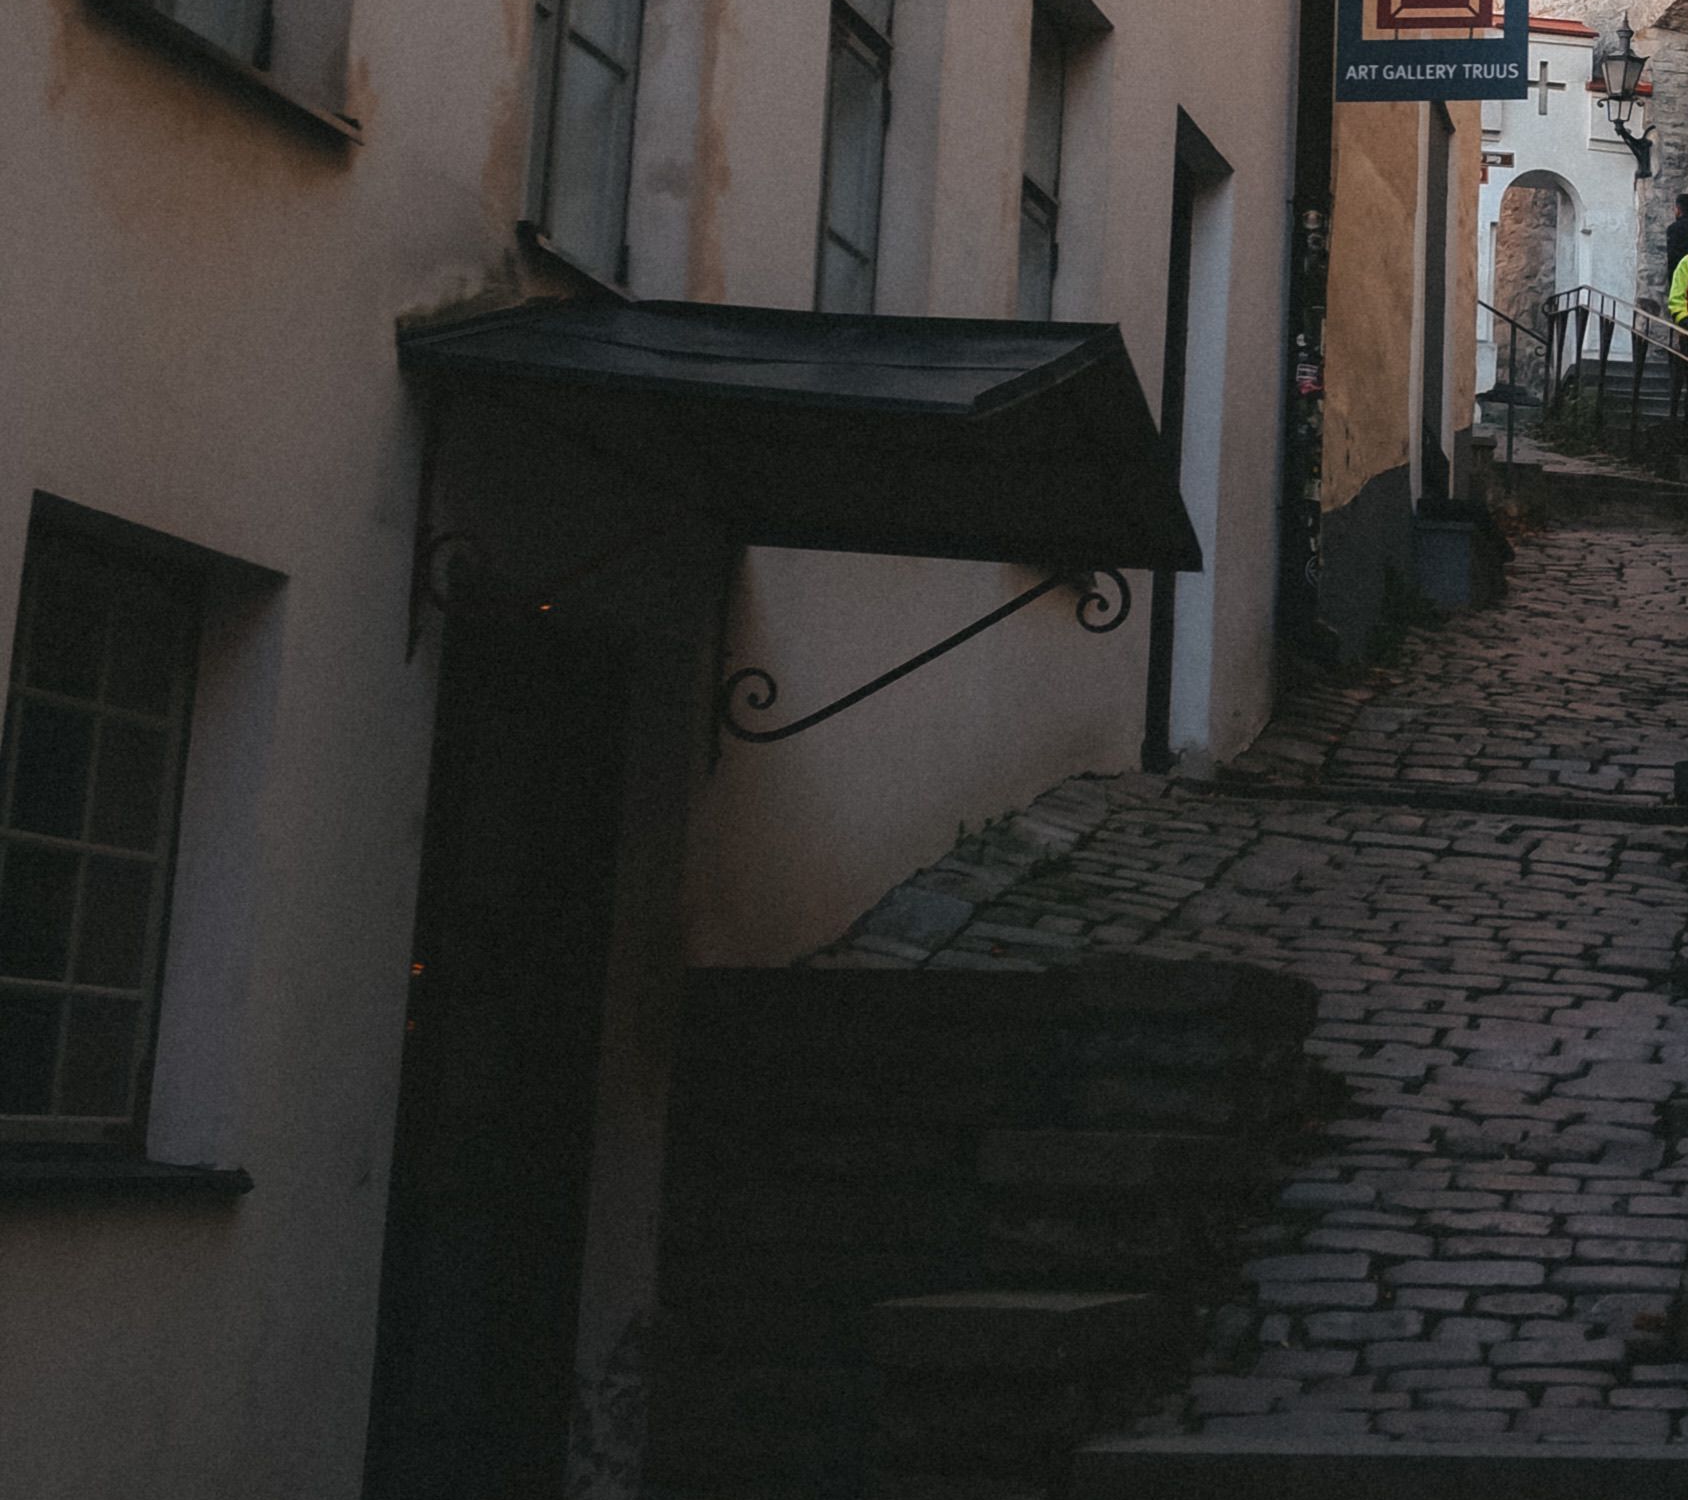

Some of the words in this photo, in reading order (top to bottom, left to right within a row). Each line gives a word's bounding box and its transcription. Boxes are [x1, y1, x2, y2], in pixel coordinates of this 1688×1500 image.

[1345, 65, 1379, 81] ART
[1383, 64, 1457, 80] GALLERY
[1464, 63, 1519, 79] TRUUS
